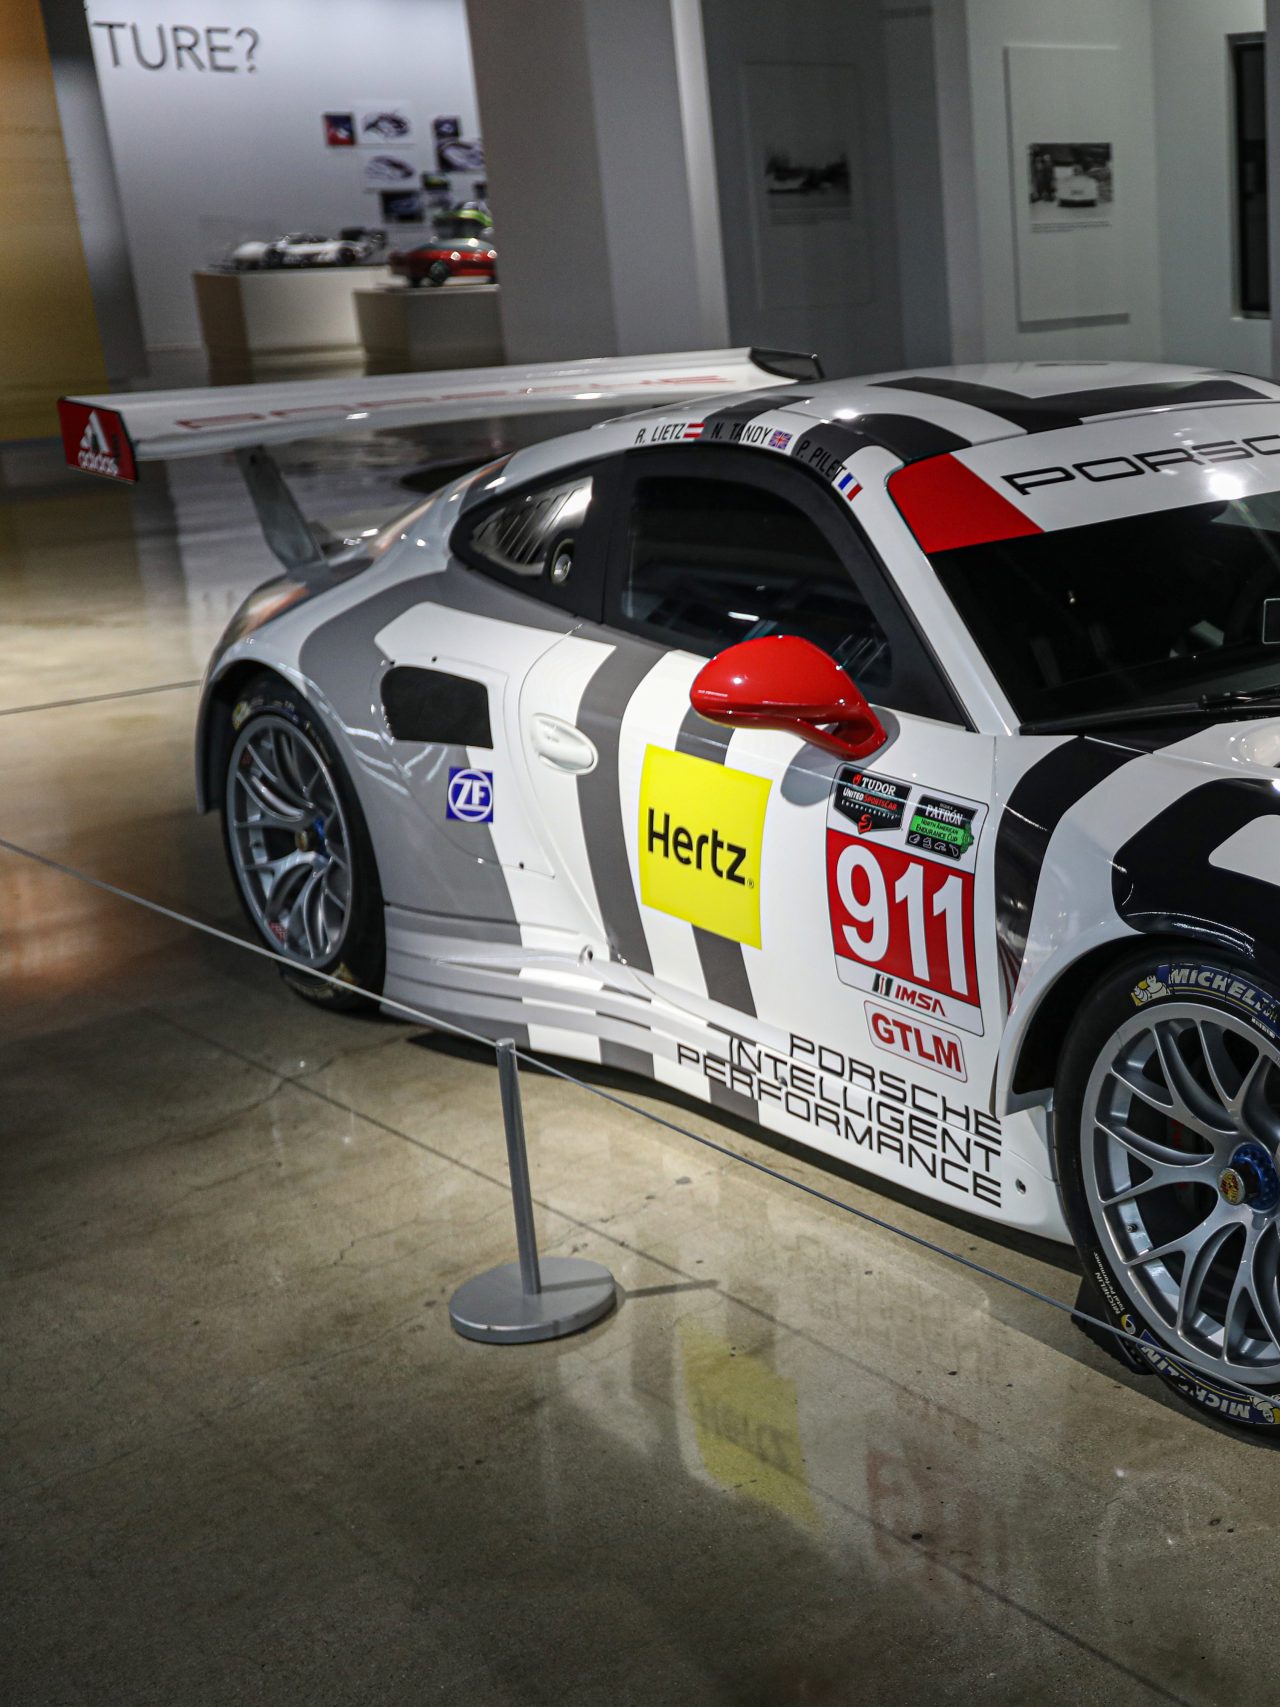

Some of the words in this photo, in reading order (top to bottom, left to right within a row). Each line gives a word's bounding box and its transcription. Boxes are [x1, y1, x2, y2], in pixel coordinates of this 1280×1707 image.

[94, 21, 261, 74] TURE?
[635, 429, 647, 445] R.
[651, 423, 685, 442] LIETZ
[711, 424, 724, 440] N.
[729, 423, 772, 445] TANDY
[796, 440, 808, 458] P.
[813, 447, 848, 479] PILET
[453, 778, 486, 811] ZF
[843, 787, 864, 801] UNITED
[861, 777, 897, 796] TUDOR
[925, 804, 963, 826] PATRÓN
[647, 806, 748, 886] Hertz
[836, 844, 971, 998] 911
[894, 984, 947, 1018] IMSA
[1168, 968, 1278, 1024] MICHEL
[871, 1012, 963, 1074] GTLM
[729, 1036, 1002, 1169] INTELLIGENT
[789, 1033, 1002, 1142] PORSCHE
[677, 1042, 1002, 1209] PERFORMANCE
[1094, 1271, 1121, 1315] MICHELIN
